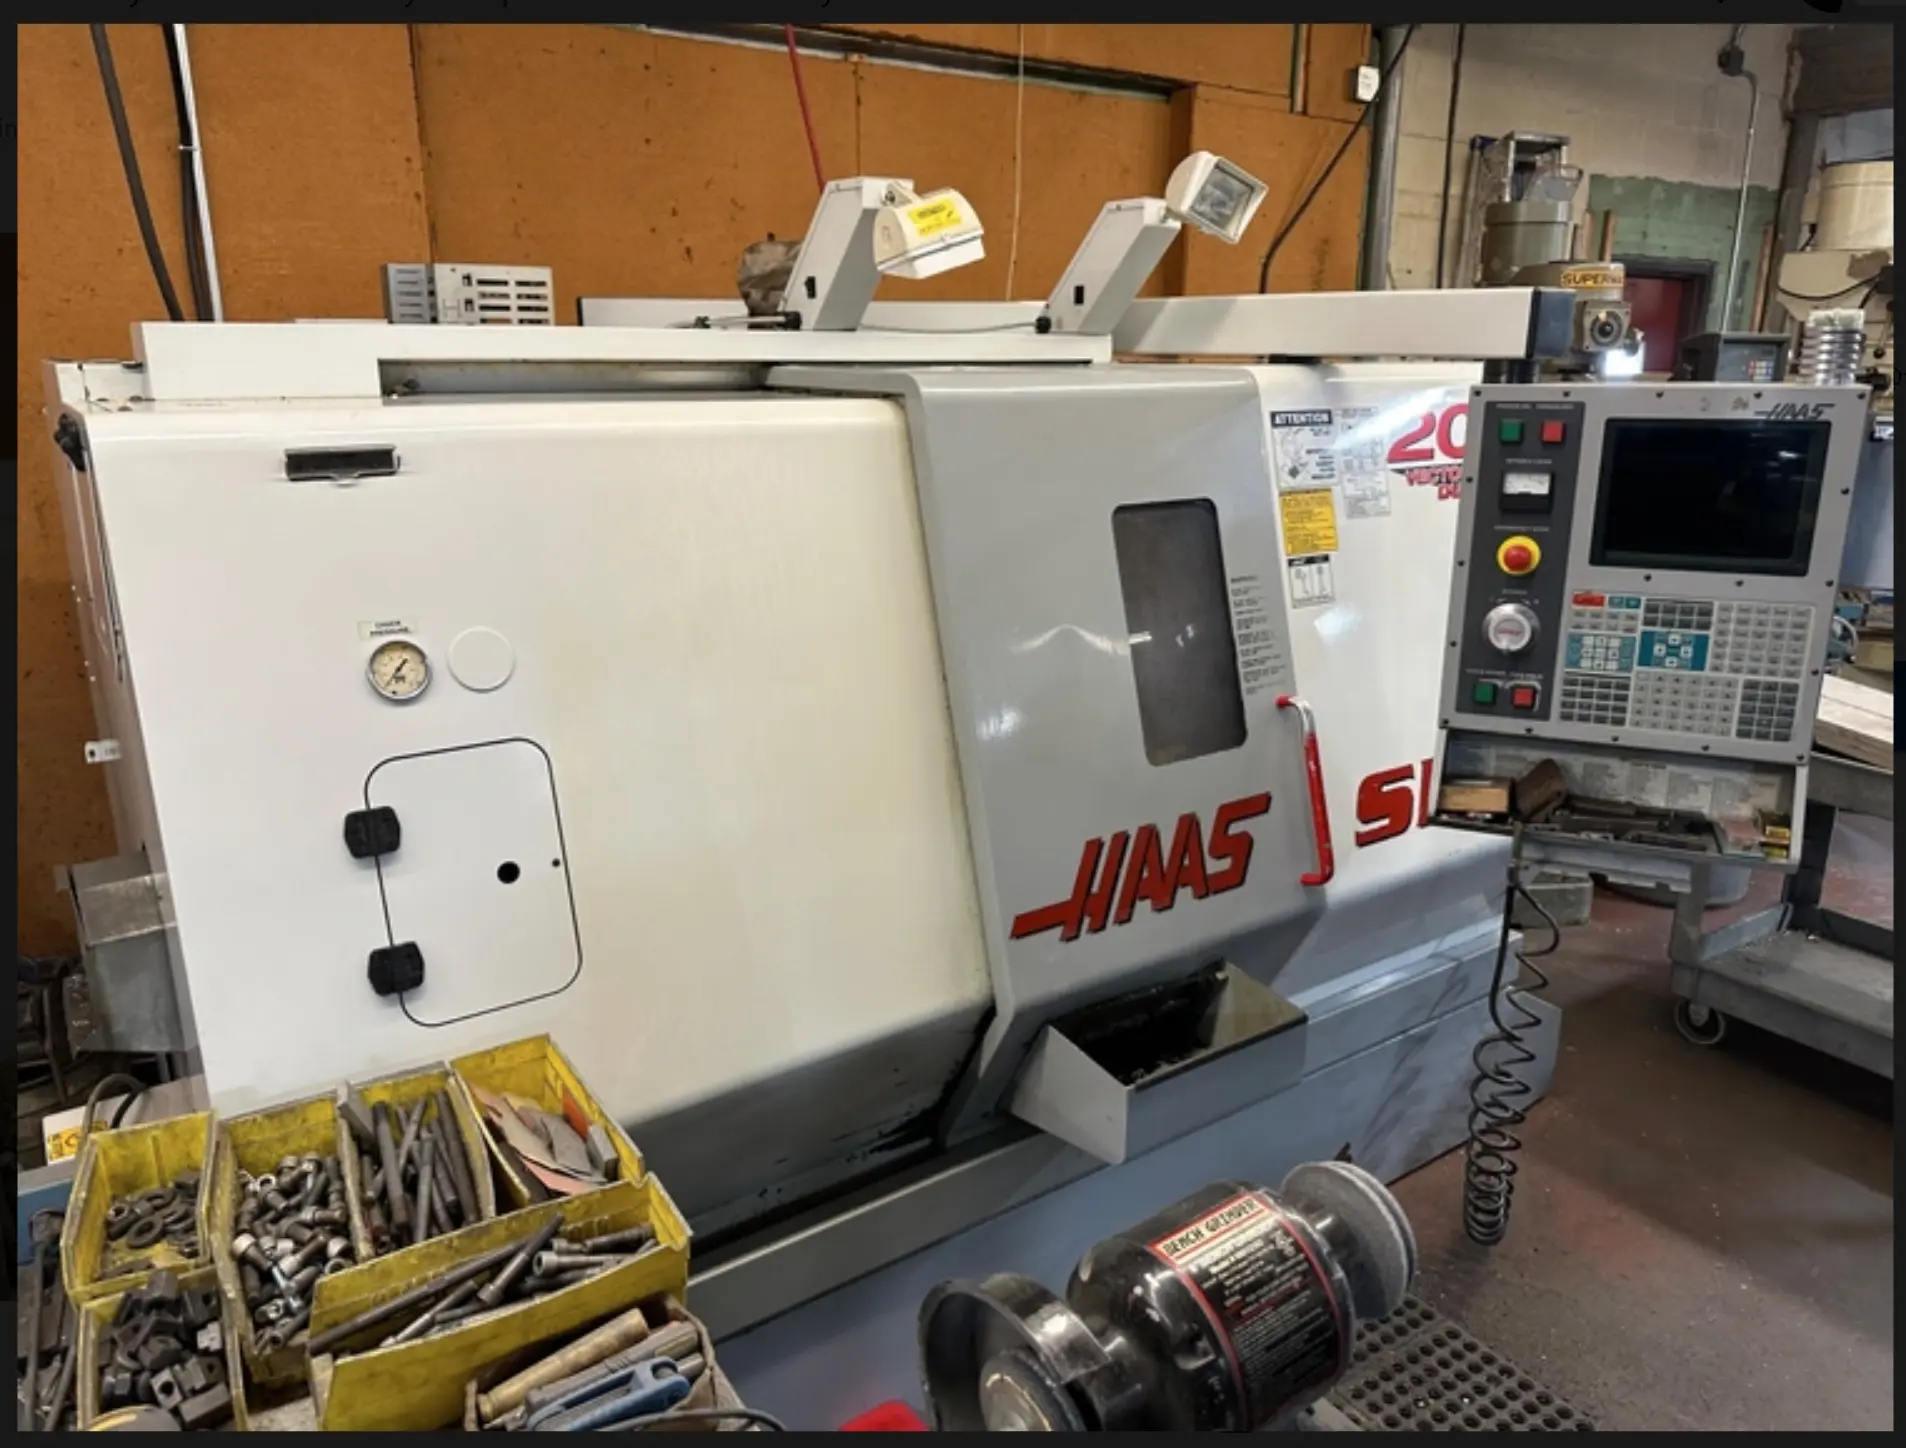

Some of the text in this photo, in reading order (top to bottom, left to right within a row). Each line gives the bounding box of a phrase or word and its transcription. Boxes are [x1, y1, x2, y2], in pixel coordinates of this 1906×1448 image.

[1274, 412, 1331, 426] ATTENTION
[1754, 403, 1836, 420] HAAS
[1009, 791, 1272, 943] HAAS
[1161, 1197, 1256, 1257] BENCH GRINDER
